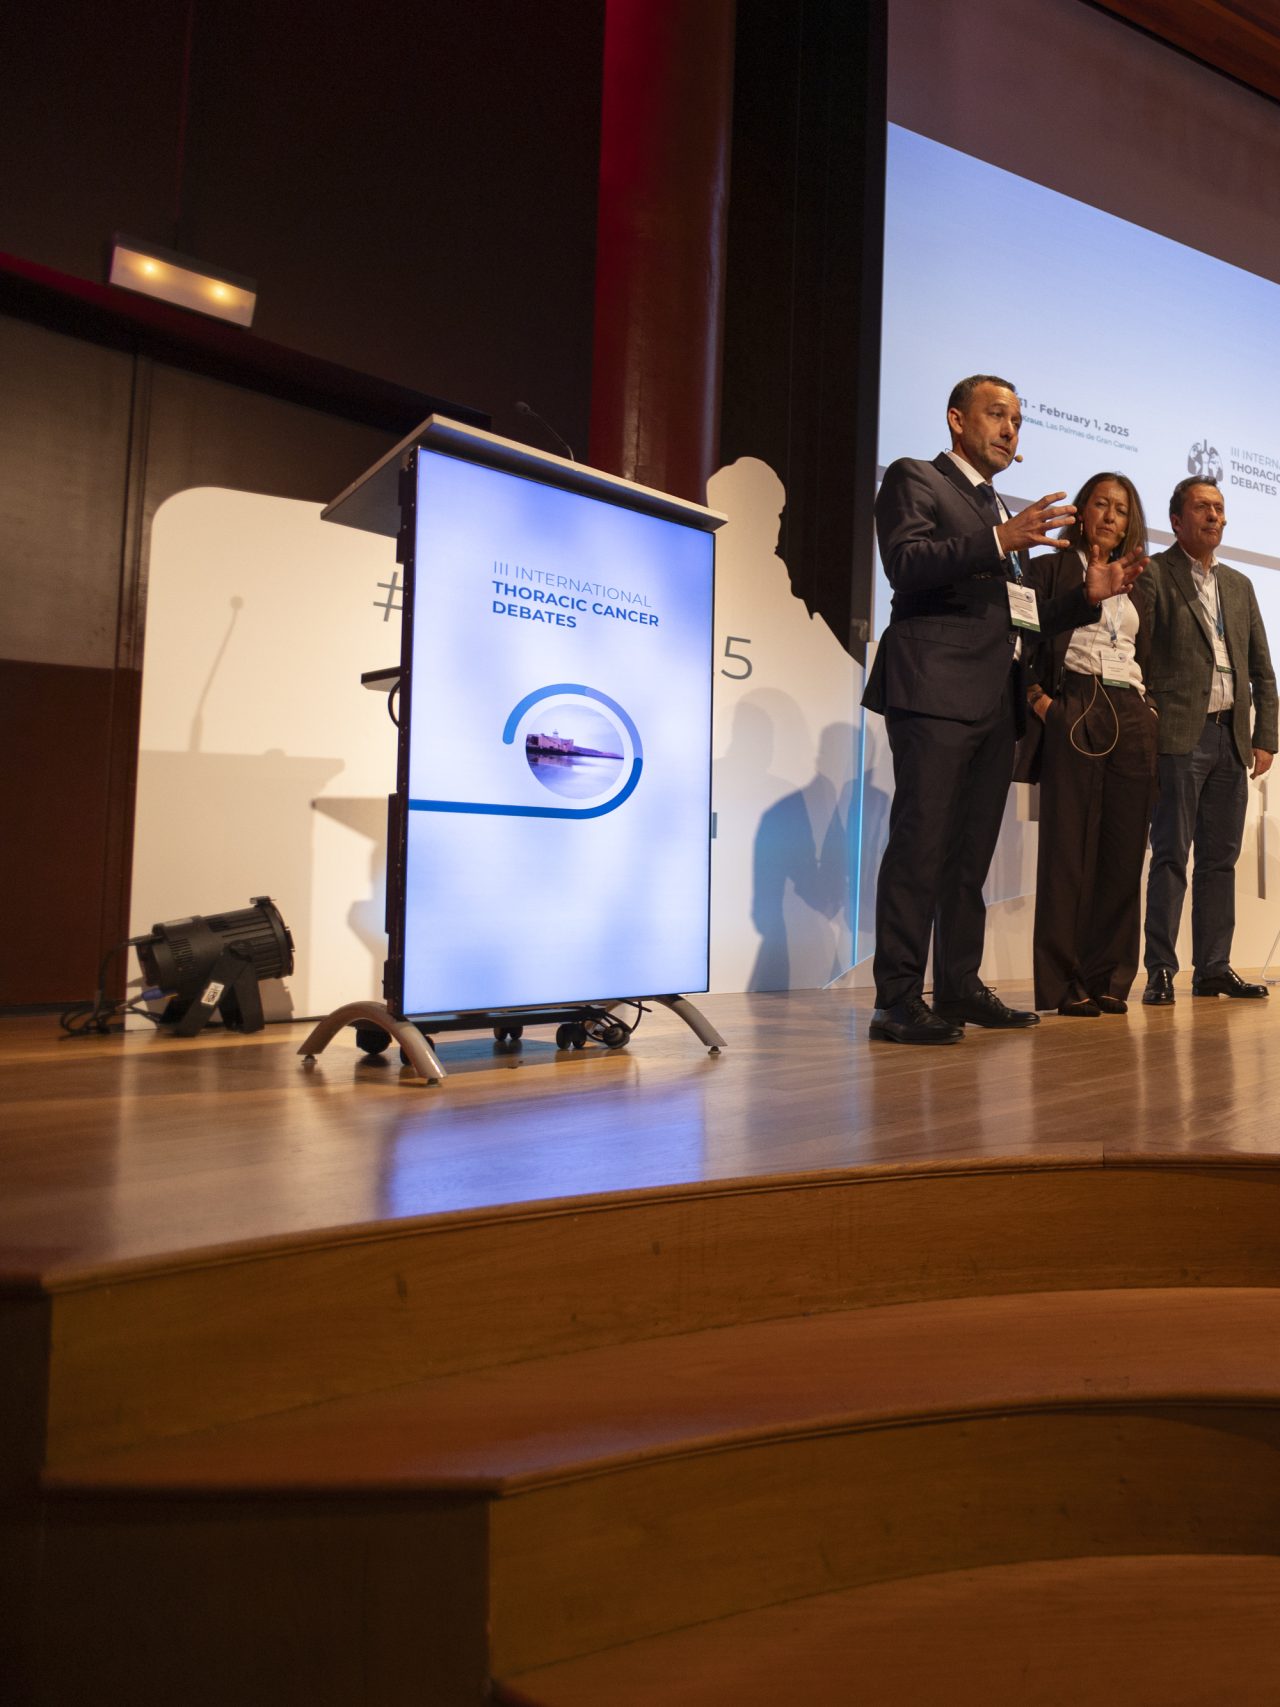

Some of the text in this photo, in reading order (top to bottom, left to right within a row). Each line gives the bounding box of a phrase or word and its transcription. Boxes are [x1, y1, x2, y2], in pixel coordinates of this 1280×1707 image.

[1040, 404, 1090, 427] February
[1094, 419, 1100, 430] 1,
[1104, 422, 1130, 437] 2025
[1046, 420, 1058, 431] Las
[1059, 424, 1085, 438] Palmas
[1086, 432, 1095, 440] de
[1096, 434, 1112, 446] Gran
[1114, 440, 1138, 453] Canaria
[1231, 446, 1240, 458] III
[1231, 475, 1278, 496] DEBATES
[493, 561, 652, 608] III INTERNATIONAL
[492, 580, 660, 627] THORACIC CANCER
[492, 600, 578, 629] DEBATES
